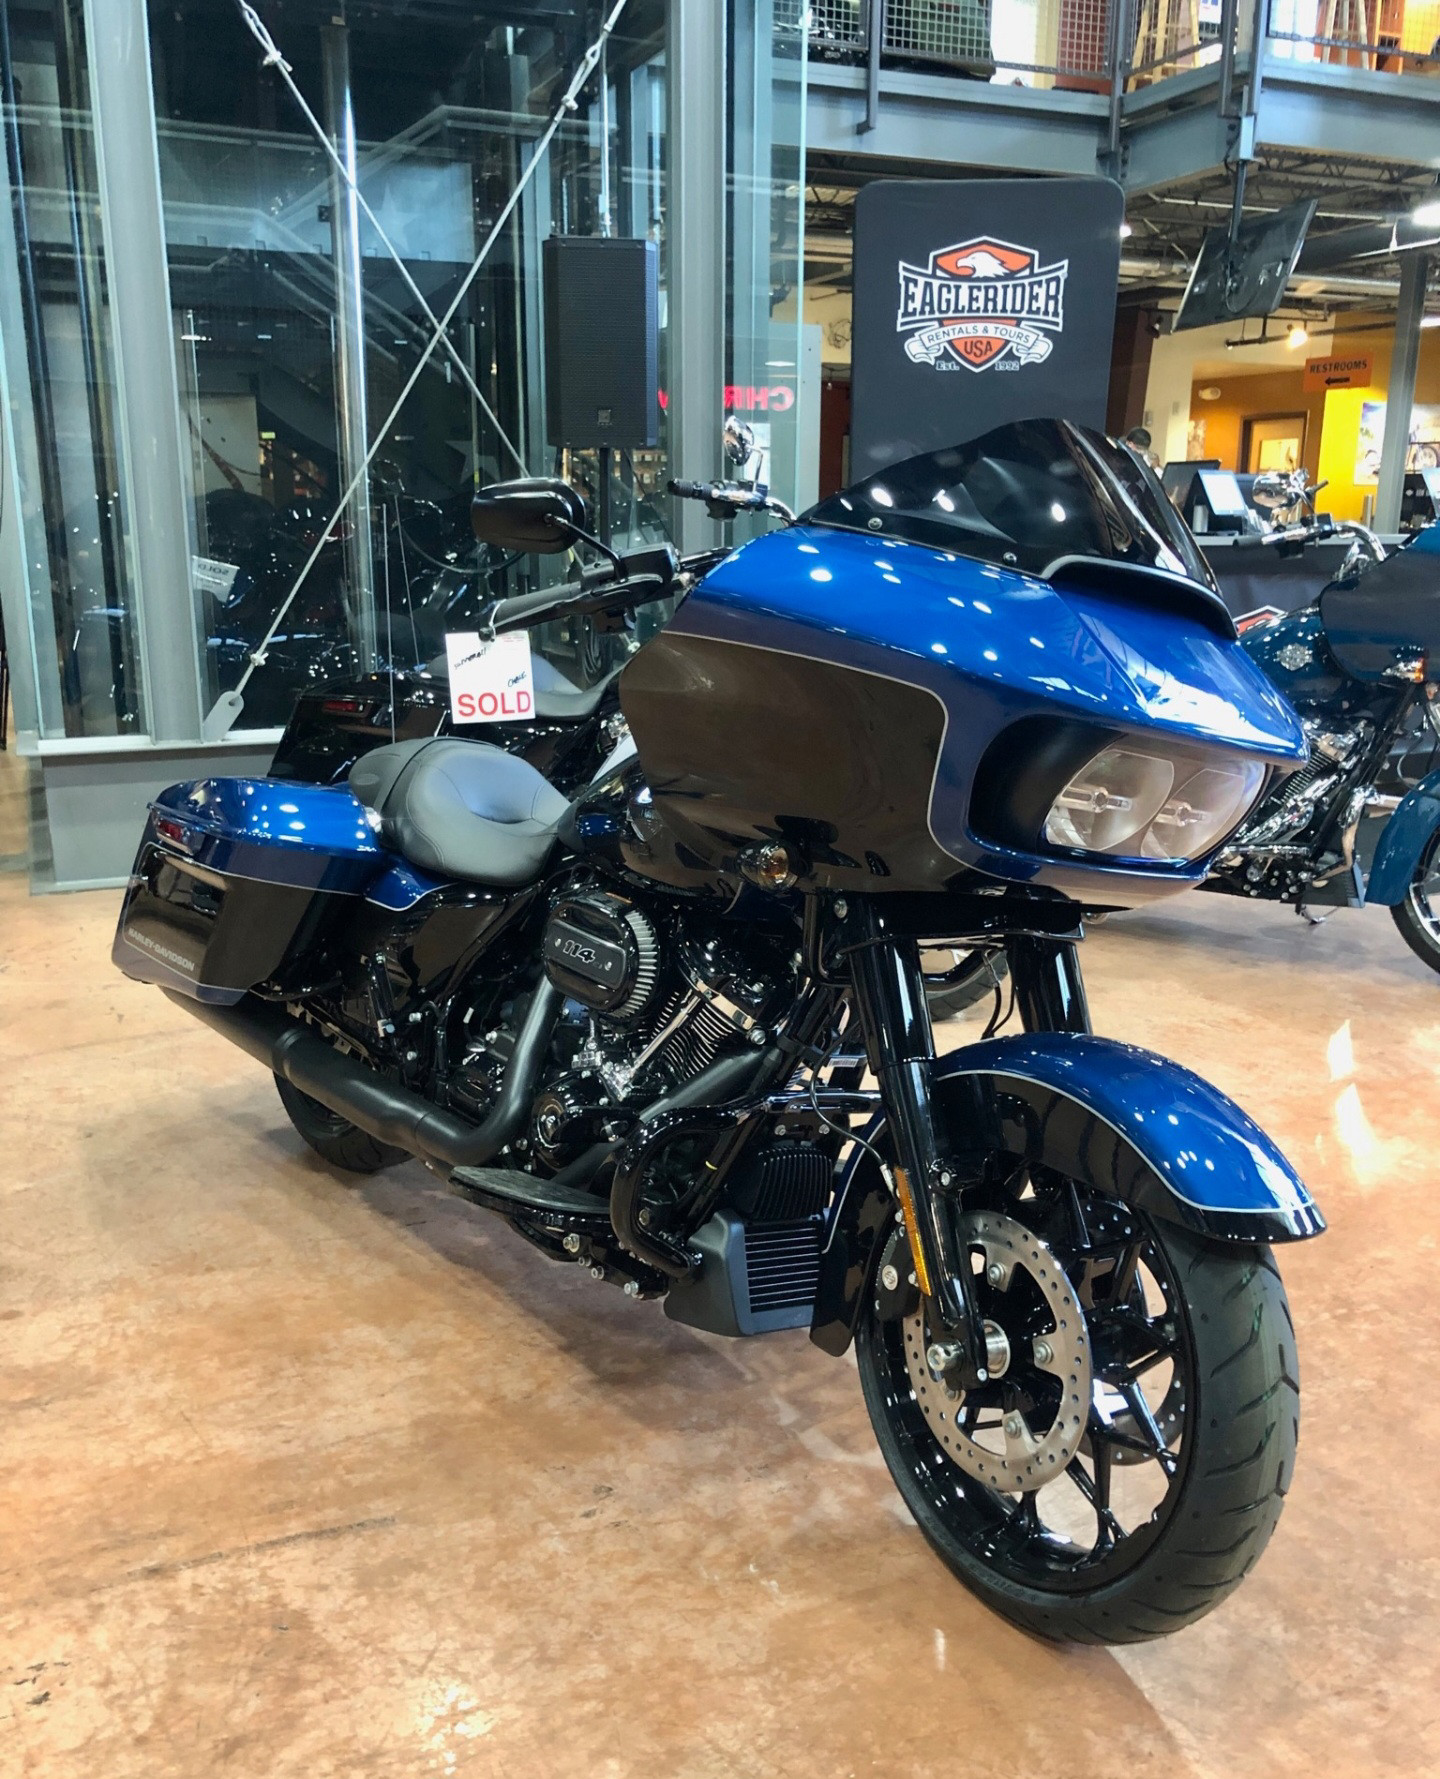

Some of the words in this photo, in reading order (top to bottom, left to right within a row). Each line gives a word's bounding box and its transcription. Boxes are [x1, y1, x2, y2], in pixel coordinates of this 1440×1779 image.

[902, 275, 1061, 319] EAGLERIDER
[927, 325, 978, 344] RENTALS
[982, 325, 989, 334] &
[994, 326, 1031, 344] TOURS
[964, 340, 993, 358] USA
[995, 361, 1020, 371] 1992
[1310, 360, 1367, 374] RESTROOMS
[457, 691, 531, 717] SOLD
[128, 928, 195, 972] HARLEY-DAVIDSON
[562, 940, 596, 963] 114
